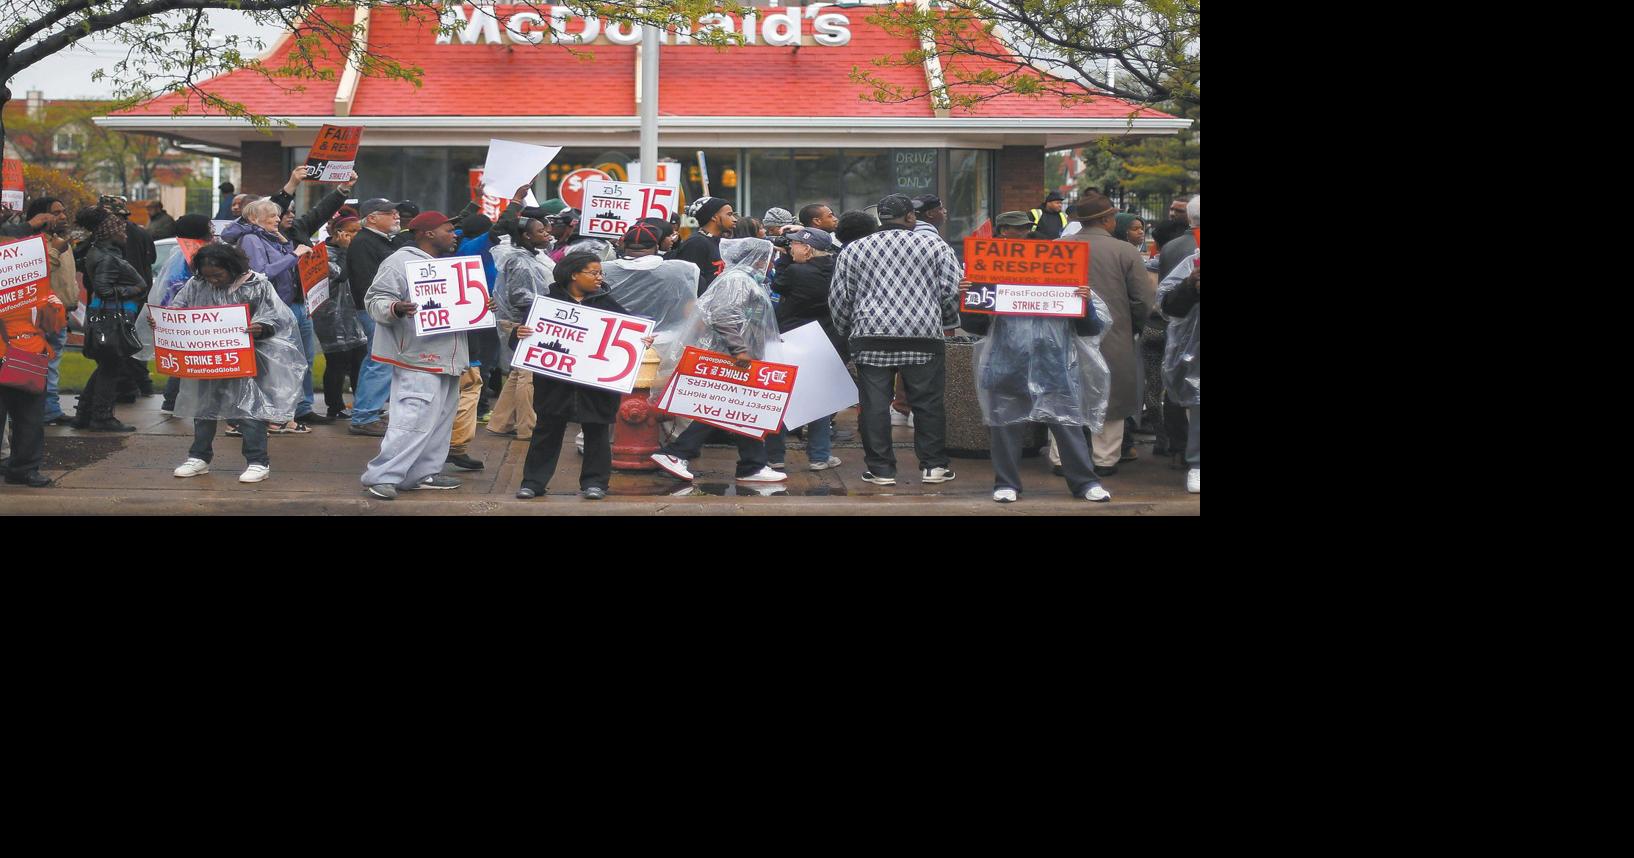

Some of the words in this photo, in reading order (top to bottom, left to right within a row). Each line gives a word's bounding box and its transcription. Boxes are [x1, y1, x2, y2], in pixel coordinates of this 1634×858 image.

[896, 152, 935, 163] DRIVE
[897, 176, 932, 189] ONLY
[591, 199, 630, 210] STRIKE
[635, 188, 673, 221] 15
[588, 218, 628, 234] FOR
[0, 245, 23, 260] AY.
[974, 240, 1025, 258] FAIR
[1034, 243, 1079, 259] PAY
[974, 259, 986, 271] &
[993, 260, 1078, 274] RESPECT
[26, 283, 37, 297] 15
[414, 283, 448, 296] STRIKE
[450, 261, 490, 325] 15
[998, 288, 1078, 298] #FastFoodGloba
[1012, 300, 1041, 310] STRIKE
[1051, 300, 1065, 313] 15
[161, 312, 187, 324] FAIR
[191, 312, 223, 324] PAY.
[419, 309, 450, 328] FOR
[535, 321, 587, 343] STRIKE
[158, 337, 169, 346] FOR
[170, 340, 185, 349] ALL
[187, 338, 243, 349] WORKERS.
[588, 317, 648, 382] 15
[184, 355, 213, 365] STRIKE
[224, 351, 239, 365] 15
[524, 346, 577, 373] FOR
[186, 366, 241, 374] #FastFoodGlobal
[694, 363, 708, 375] 15
[718, 370, 750, 381] STRIKE
[685, 377, 738, 393] WORKERS.
[676, 388, 707, 399] RIGHTS.
[709, 394, 727, 402] OUR
[742, 387, 759, 397] ALL
[761, 393, 782, 401] FOR
[728, 397, 745, 406] FOR
[745, 402, 782, 412] RESPECT
[693, 403, 722, 417] PAY.
[725, 409, 758, 424] FAIR
